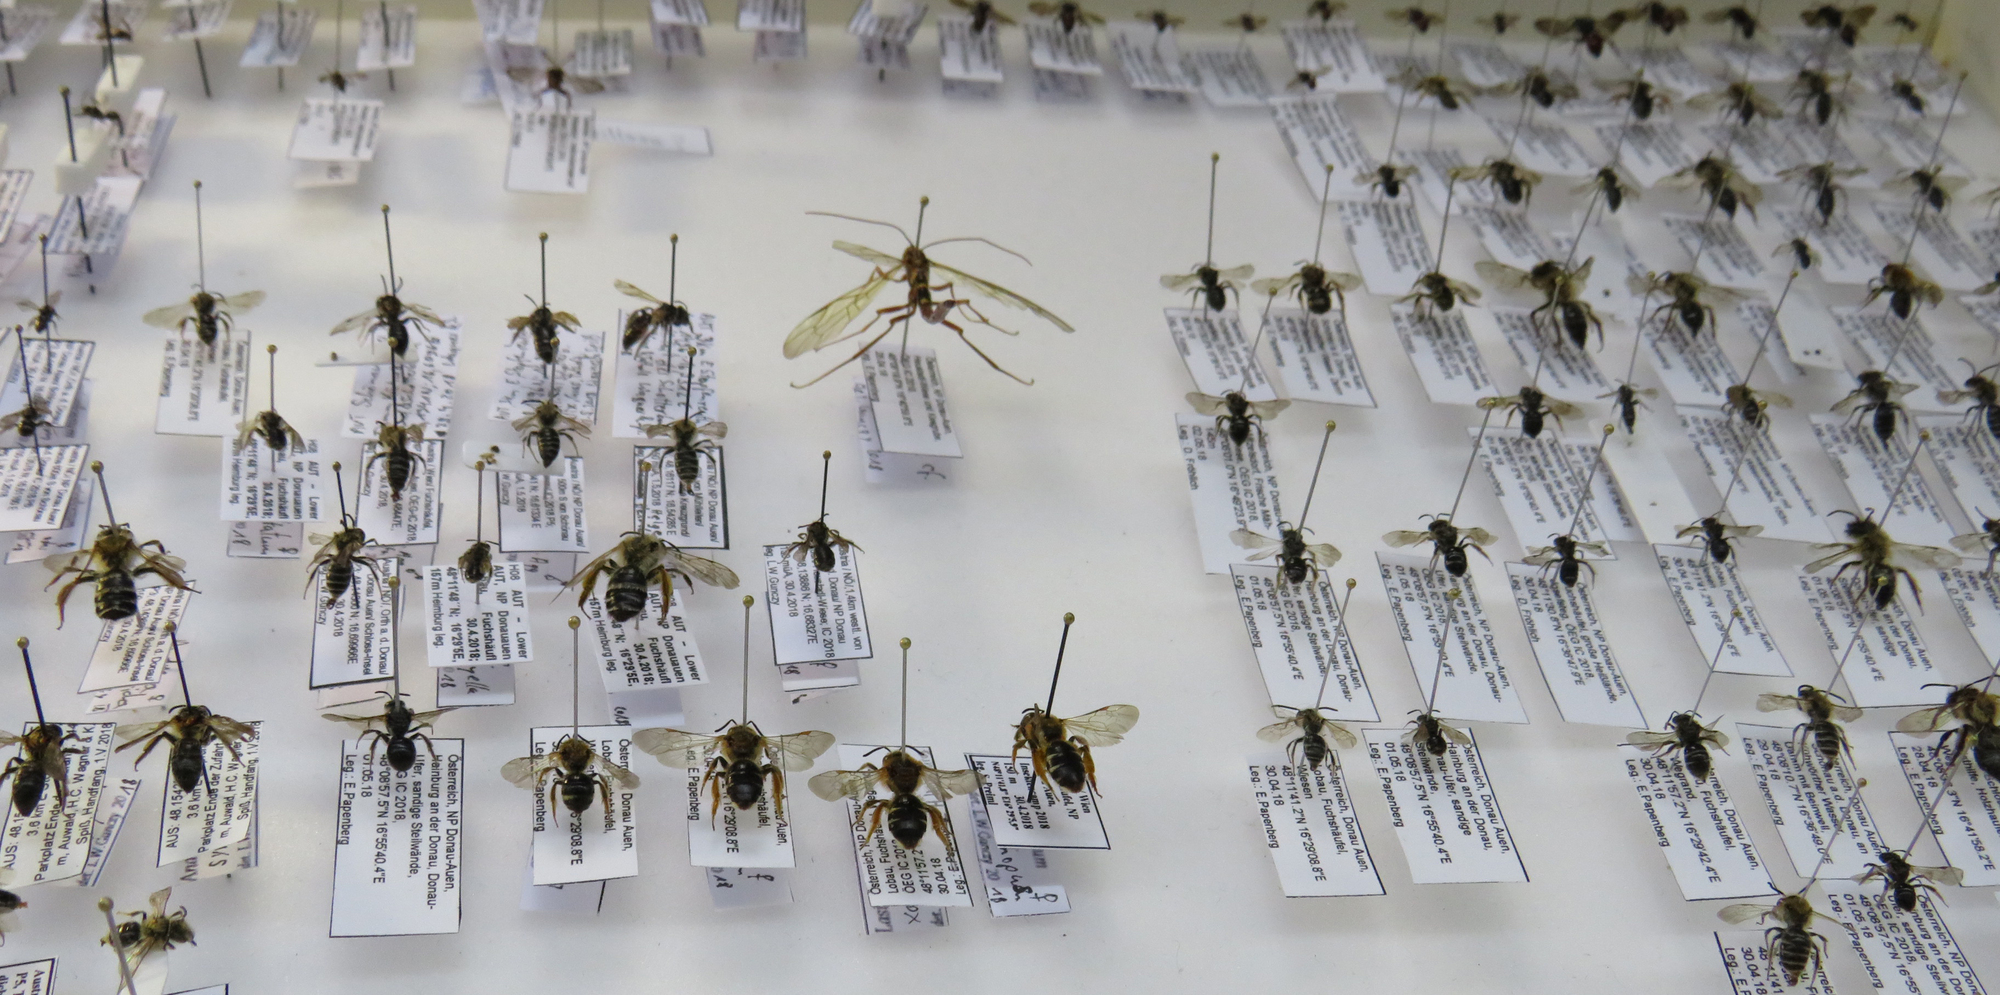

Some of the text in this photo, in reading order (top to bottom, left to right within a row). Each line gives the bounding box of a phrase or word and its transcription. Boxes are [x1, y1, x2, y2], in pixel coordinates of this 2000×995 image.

[496, 592, 508, 603] NP
[512, 590, 524, 607] AUT
[498, 610, 511, 660] Donauauen
[516, 632, 527, 658] Lower
[672, 615, 686, 632] AUT
[685, 655, 700, 681] Lower
[396, 782, 407, 792] IC
[409, 781, 423, 819] sandige
[1462, 786, 1472, 797] an
[1467, 800, 1479, 815] der
[430, 801, 439, 815] an
[622, 793, 632, 822] Donau
[1452, 800, 1471, 836] sandige
[1481, 794, 1499, 825] Donau
[429, 816, 439, 832] der
[444, 755, 461, 892] Österreich, NP Donau-Auen,
[1343, 816, 1359, 846] Donau
[1724, 809, 1745, 840] Donau
[34, 832, 55, 881] Parkplatz
[427, 835, 440, 870] Donau,
[1902, 922, 1929, 961] sandige
[1928, 943, 1953, 975] an der
[1949, 952, 1965, 967] NP
